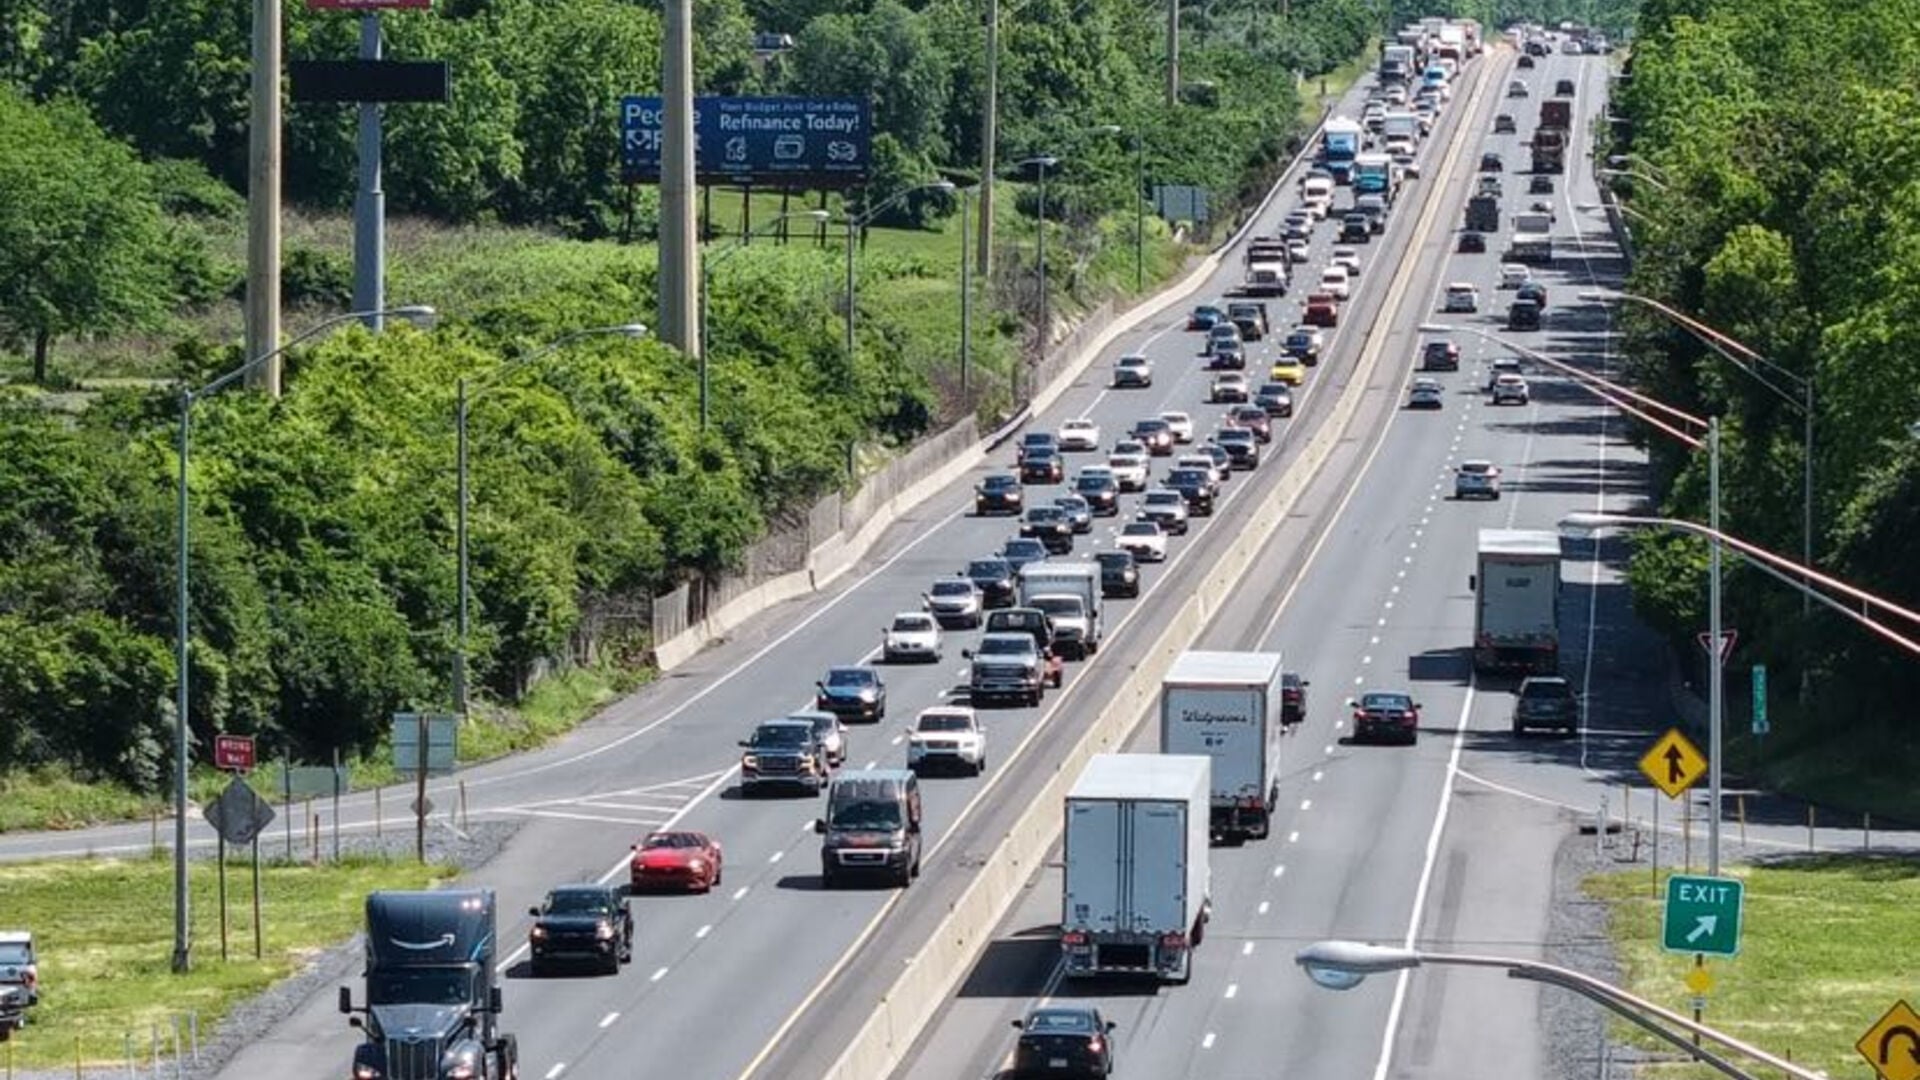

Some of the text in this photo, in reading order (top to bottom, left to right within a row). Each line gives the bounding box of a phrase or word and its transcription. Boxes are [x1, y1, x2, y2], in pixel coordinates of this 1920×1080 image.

[721, 114, 860, 133] Refinance Today!
[1679, 884, 1730, 904] EXIT
